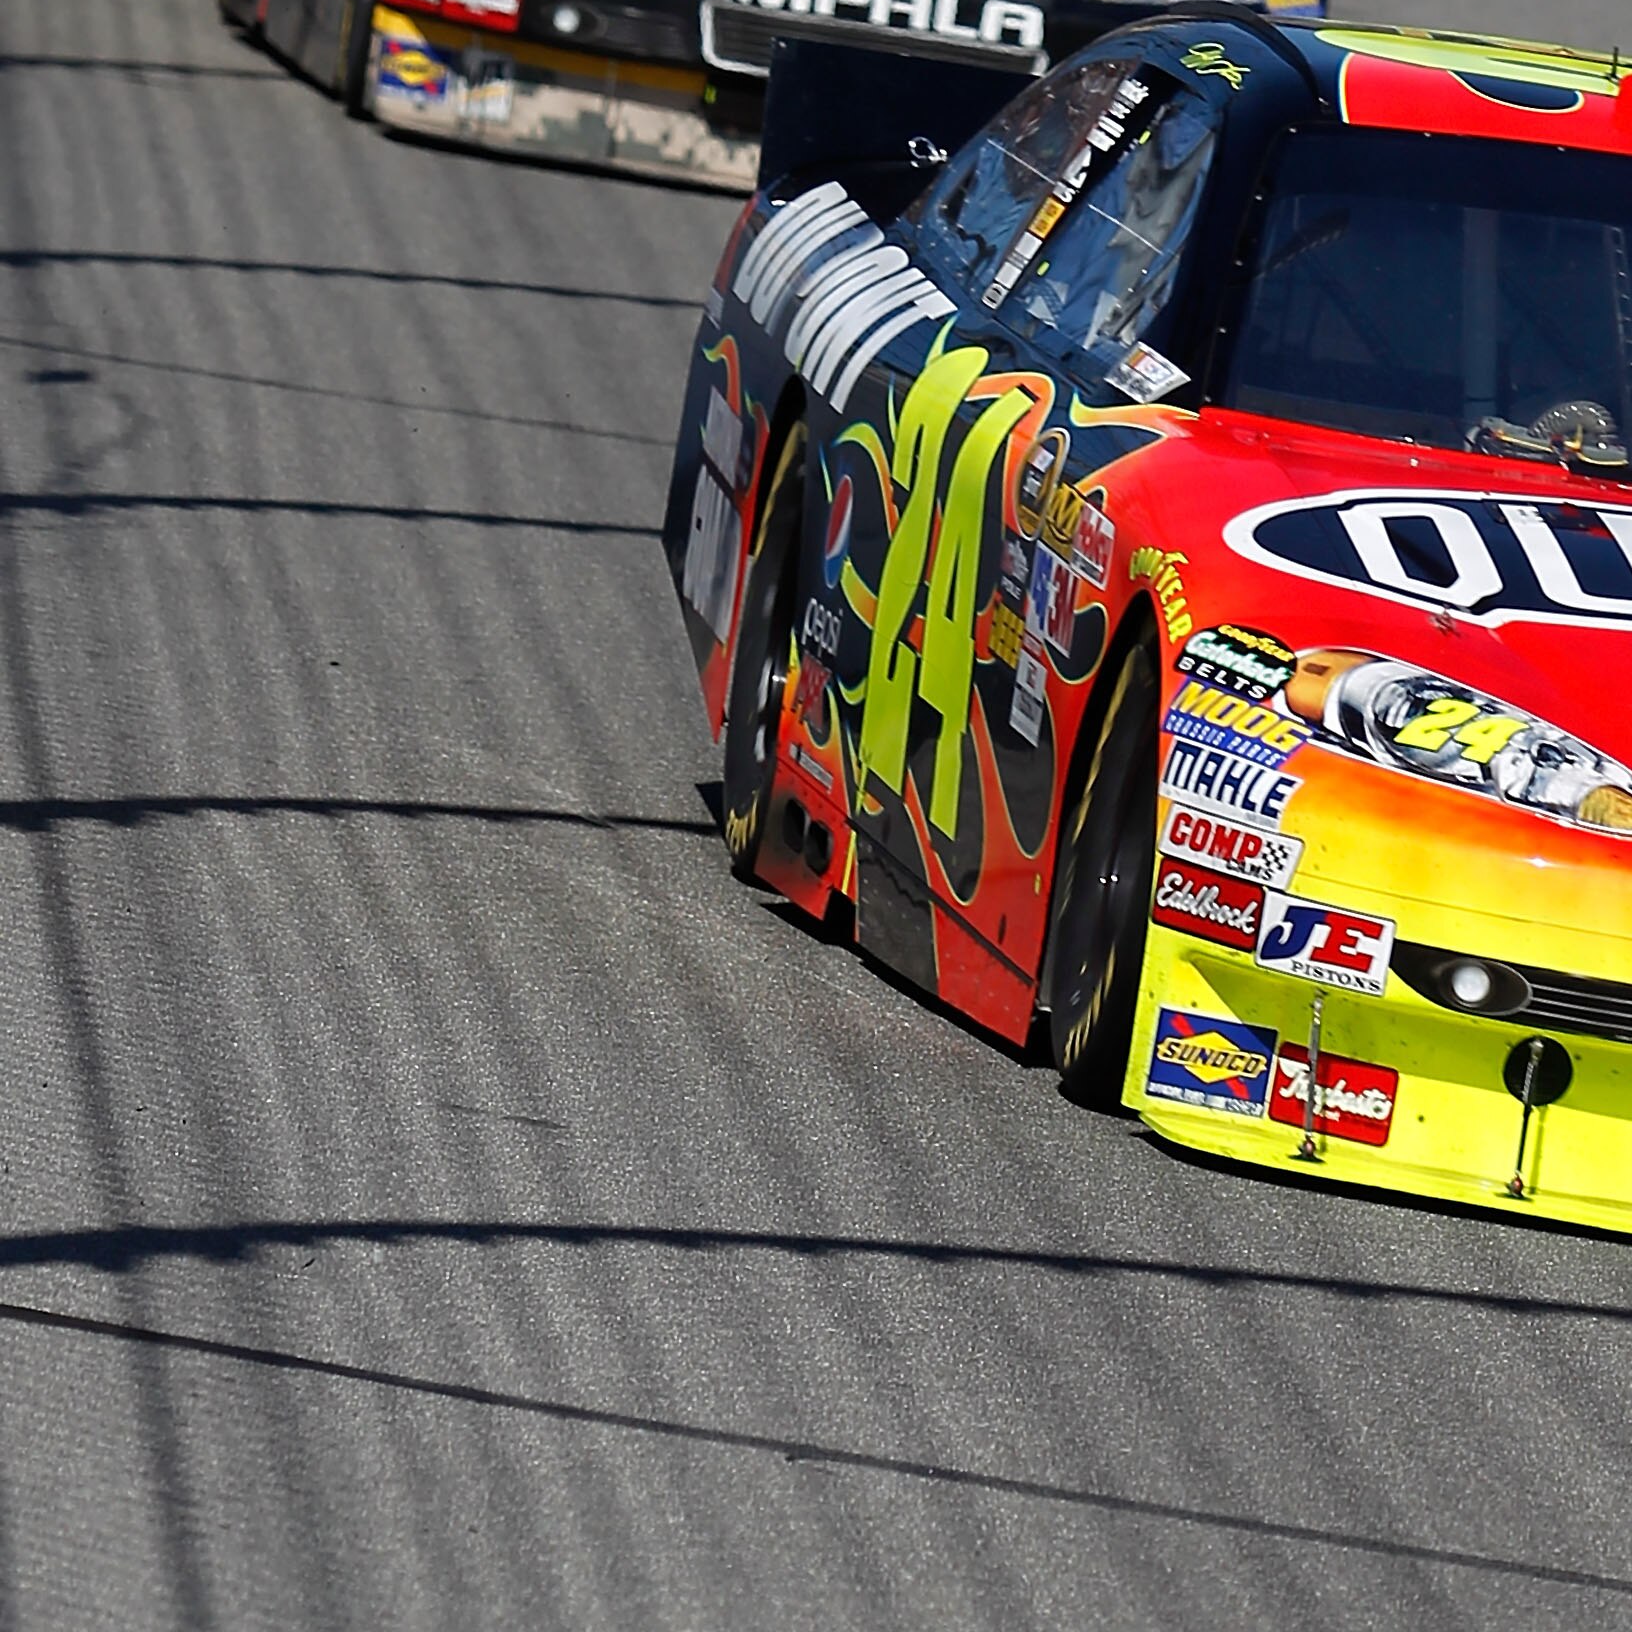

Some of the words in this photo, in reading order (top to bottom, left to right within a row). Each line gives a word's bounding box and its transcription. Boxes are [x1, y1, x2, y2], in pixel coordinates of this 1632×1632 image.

[858, 346, 1038, 841] 24
[1178, 655, 1268, 700] BELTS
[1170, 680, 1314, 754] MOOG
[1393, 697, 1533, 764] 24
[1163, 739, 1298, 819] MAHLE
[1226, 733, 1288, 768] PARTS
[1168, 811, 1264, 862] COMP
[1156, 871, 1259, 934] Edelbrock
[1259, 904, 1385, 973] JE
[1290, 958, 1384, 993] PISTONS
[1162, 1040, 1263, 1074] SUNOCO
